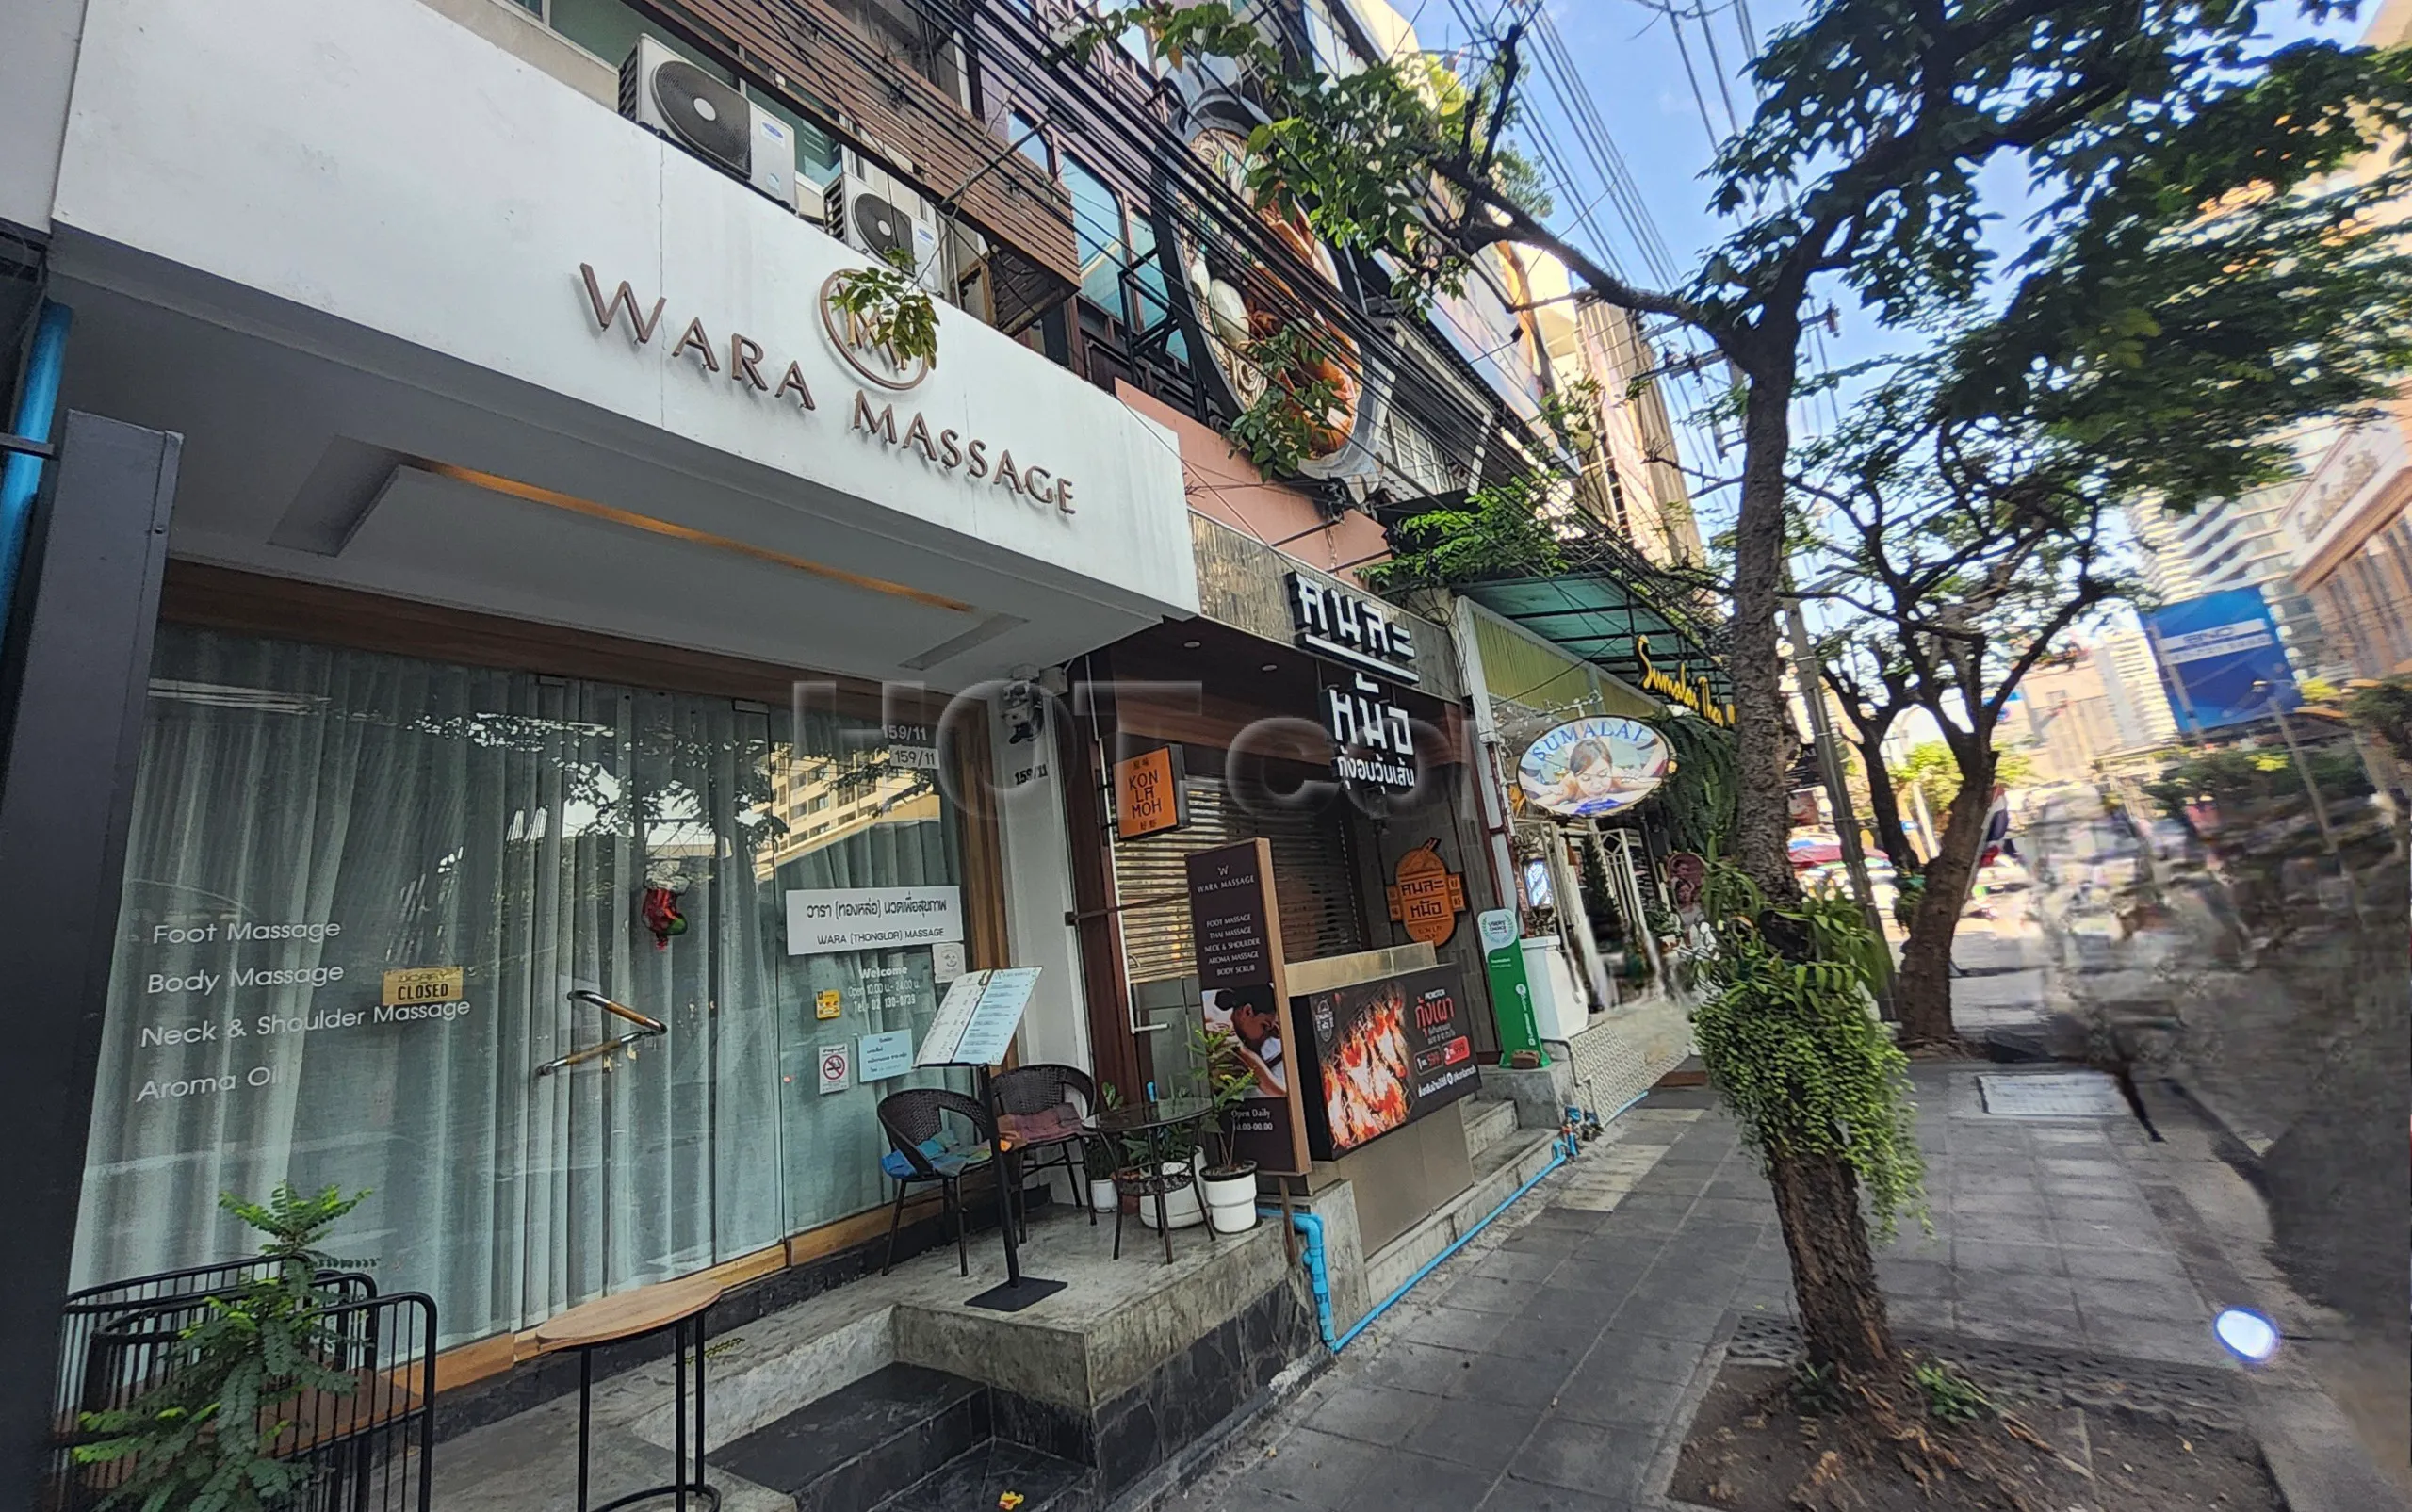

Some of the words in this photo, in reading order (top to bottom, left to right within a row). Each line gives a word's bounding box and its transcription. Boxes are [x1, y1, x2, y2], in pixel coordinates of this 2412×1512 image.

[579, 262, 816, 412] WARA
[853, 388, 1076, 515] MASSAGE
[1294, 571, 1417, 659] คนละ
[1329, 671, 1415, 756] หม้อ
[883, 724, 927, 741] 159/11
[1531, 721, 1645, 762] SUMALAI
[895, 749, 936, 767] 159/11
[1014, 763, 1049, 786] 159/11
[1336, 744, 1416, 795] กุ้งอบวุ้นเส้น
[1128, 769, 1159, 790] KON
[1134, 786, 1155, 803] LA
[1131, 798, 1163, 819] MOH
[1197, 882, 1219, 893] WARA
[1220, 874, 1255, 889] MASSAGE
[1400, 879, 1446, 897] คนละ
[807, 904, 833, 919] วารา
[1206, 919, 1223, 928] FOOT
[1224, 913, 1252, 924] MASSAGE
[152, 923, 218, 944] Foot
[227, 920, 342, 942] Massage
[817, 934, 847, 945] WARA
[850, 929, 903, 944] (THONGLOR)
[904, 927, 945, 938] MASSAGE
[1210, 931, 1224, 939] THAI
[1225, 925, 1252, 937] MASSAGE
[1204, 942, 1221, 953] NECK
[1228, 937, 1261, 951] SHOULDER
[1208, 953, 1230, 965] AROMA
[1230, 950, 1260, 962] MASSAGE
[147, 970, 220, 996] Body
[230, 965, 345, 988] Massage
[857, 967, 909, 979] Welcome
[1216, 966, 1234, 977] BODY
[397, 983, 449, 1000] CLOSED
[847, 985, 866, 999] Open
[140, 1020, 217, 1048] Neck
[227, 1018, 248, 1039] &
[256, 1007, 366, 1036] Shoulder
[372, 1000, 471, 1022] Massage
[1414, 996, 1455, 1037] กุ้งเผา
[136, 1074, 236, 1102] Aroma
[247, 1065, 282, 1087] Oil
[1230, 1109, 1250, 1120] Open
[1251, 1107, 1271, 1120] Daily
